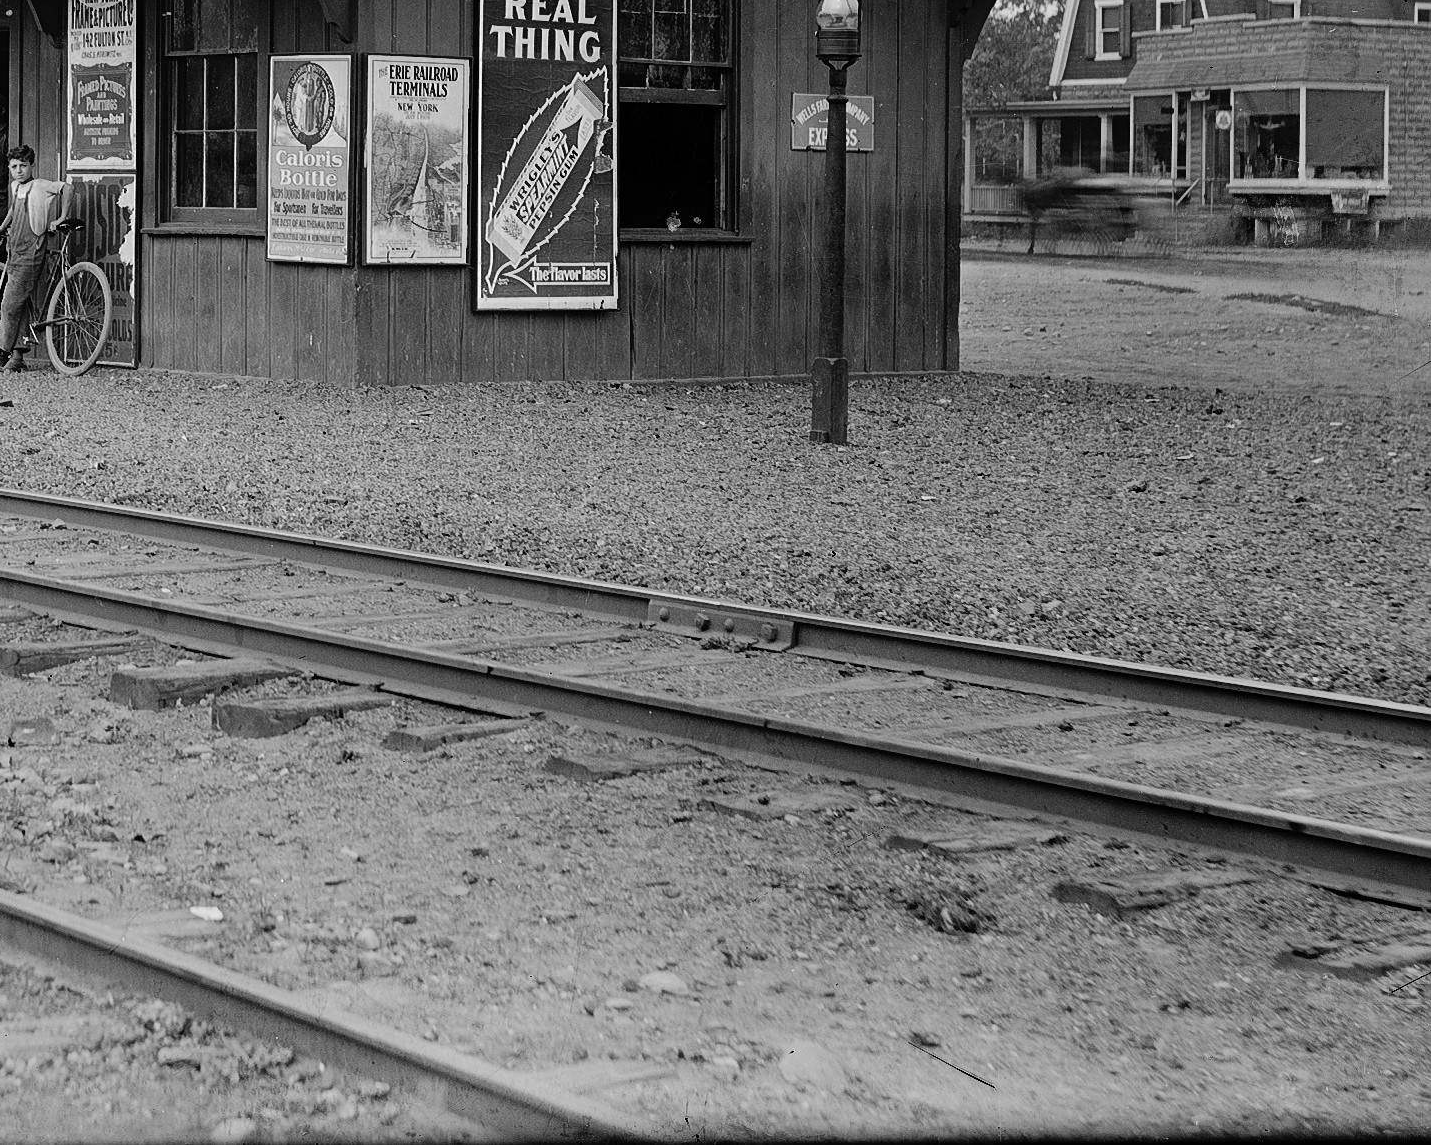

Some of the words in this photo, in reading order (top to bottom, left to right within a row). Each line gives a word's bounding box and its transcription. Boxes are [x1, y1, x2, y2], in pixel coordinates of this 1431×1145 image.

[82, 32, 93, 47] 142
[94, 31, 115, 47] FULTON
[489, 25, 601, 63] THING
[389, 64, 411, 80] ERIE
[413, 65, 459, 82] RAILROAD
[389, 80, 448, 98] TERMINALS
[397, 102, 413, 112] NEW
[418, 102, 439, 113] YORK
[795, 103, 817, 126] WELLS
[77, 113, 103, 125] Wholesale
[109, 112, 125, 125] Retail
[809, 127, 858, 147] EXPSS
[275, 149, 344, 168] Caloris
[279, 168, 338, 187] Bottle
[509, 130, 562, 212] WRIGLEY'S
[517, 135, 570, 225] SPEARMINT
[527, 179, 562, 230] PEPSIN
[558, 148, 580, 179] GUM
[271, 217, 279, 227] THE
[279, 218, 292, 228] BEST
[529, 266, 549, 282] The
[549, 266, 582, 282] flavor
[582, 266, 607, 282] lasts
